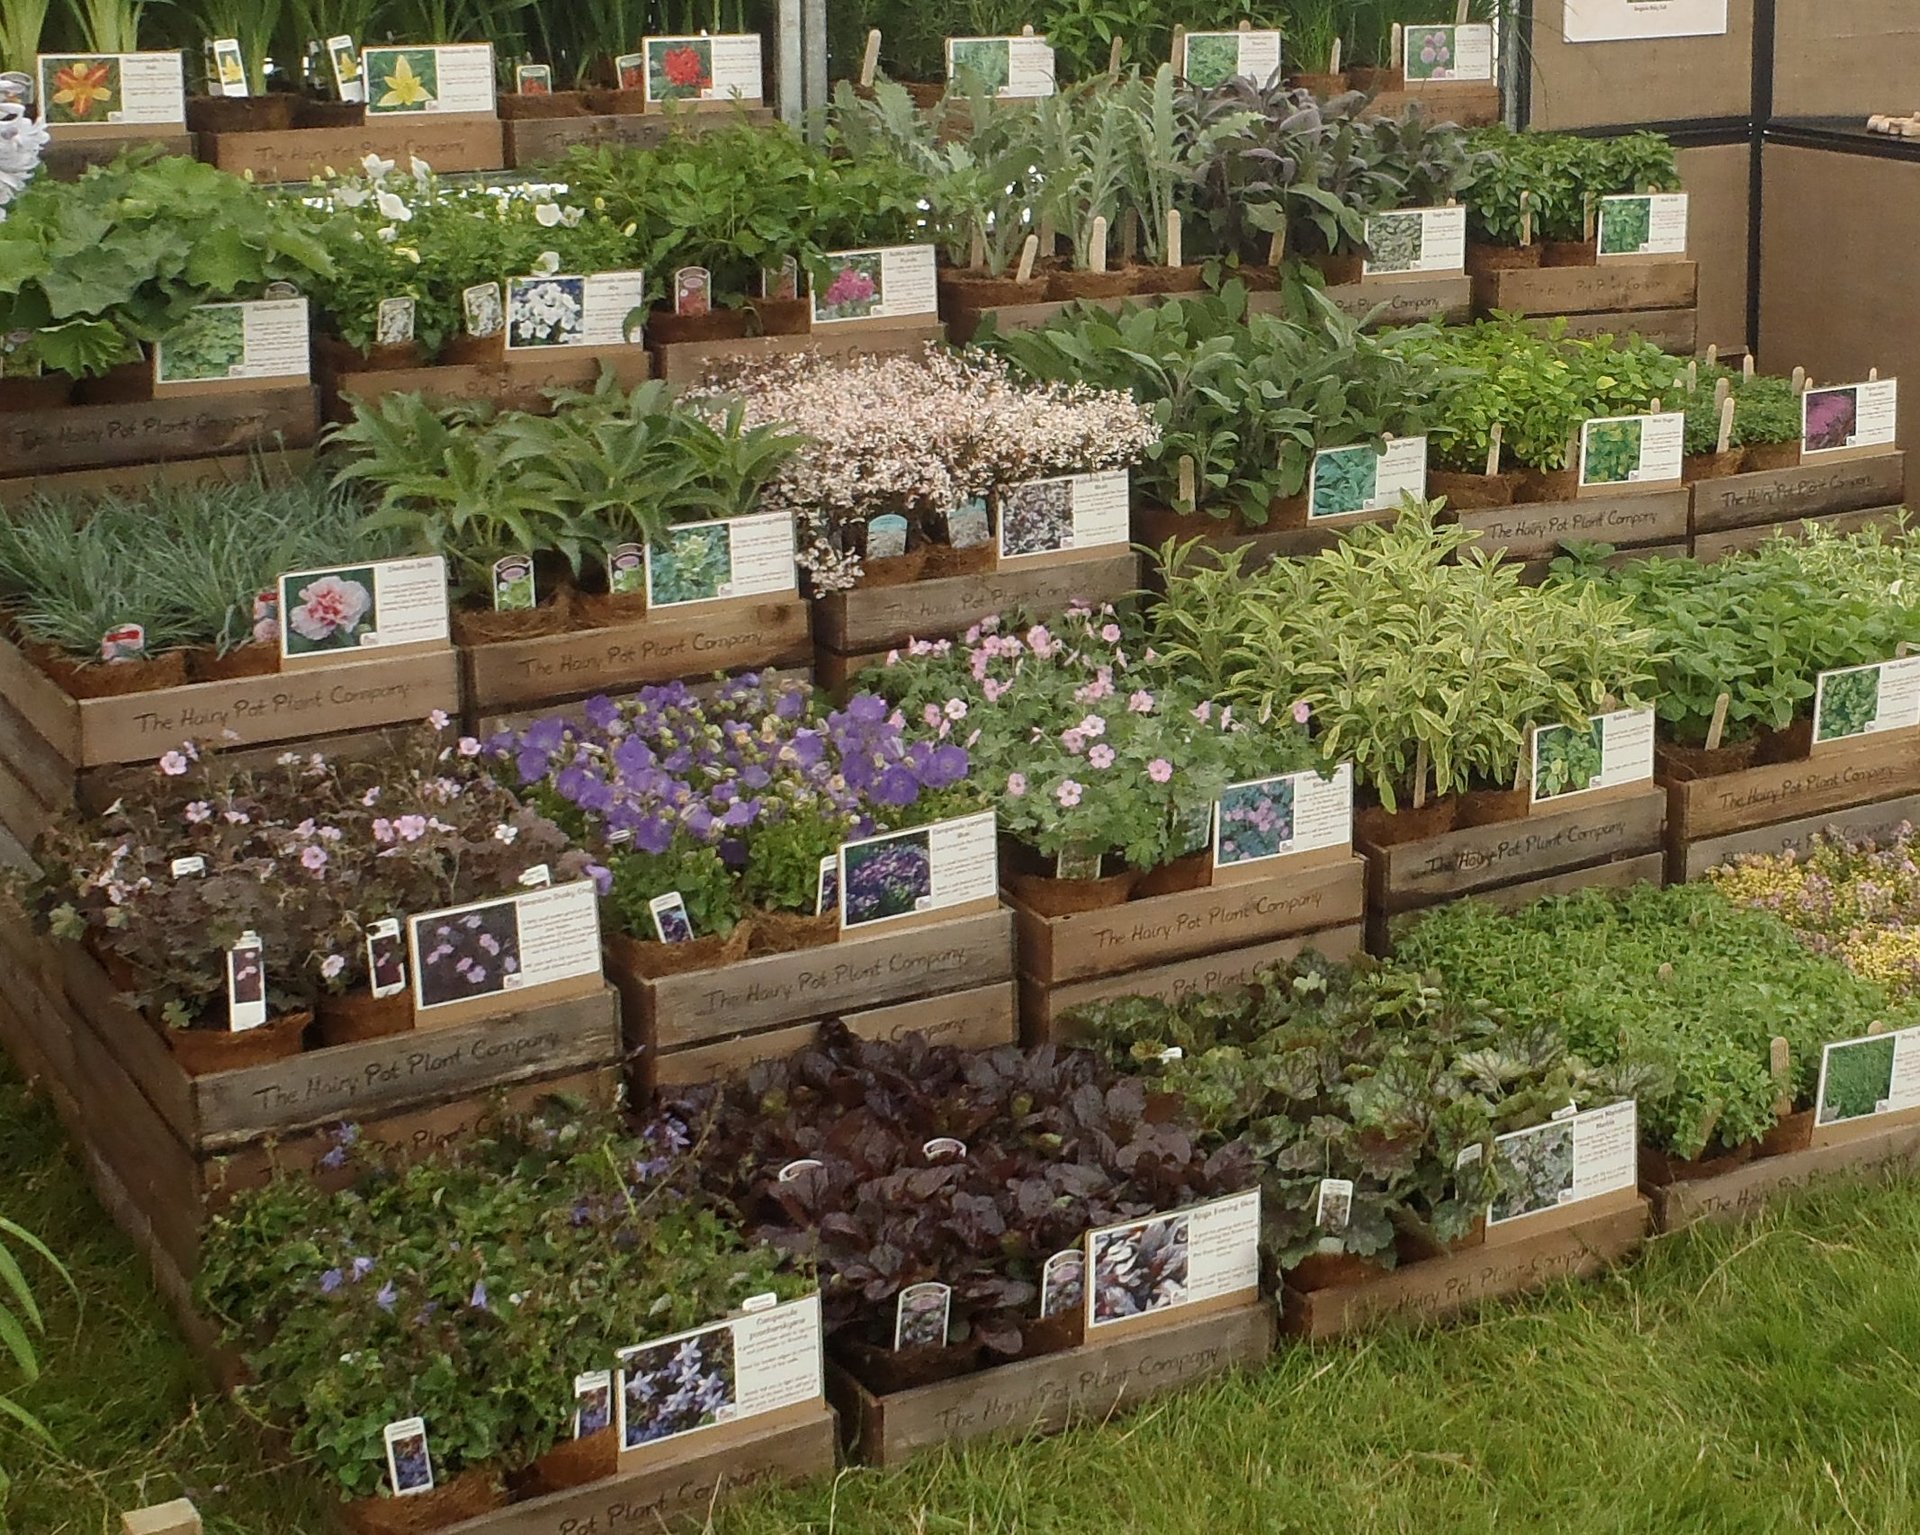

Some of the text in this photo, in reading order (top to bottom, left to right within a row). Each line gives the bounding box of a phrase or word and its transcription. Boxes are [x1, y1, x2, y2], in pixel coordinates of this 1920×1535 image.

[1390, 293, 1440, 313] Company
[1488, 509, 1659, 540] The Hairy Pot Plant Company
[518, 657, 553, 677] The
[607, 645, 637, 664] Pot
[641, 639, 686, 660] Plant
[691, 632, 764, 652] Company
[133, 683, 408, 734] The Hairy Pot Plant Company
[1718, 765, 1895, 809] The Hairy Pot Plant Company
[1457, 851, 1495, 871] Hairy
[1498, 840, 1522, 861] Pot
[1525, 834, 1564, 854] Plant
[1566, 820, 1627, 844] Company
[1093, 890, 1324, 949] The Hairy Pot Plant Company
[701, 948, 969, 1014] The Hairy Pot Plant Company
[1203, 967, 1248, 991] Plant
[252, 1031, 562, 1110] The Hairy Pot Plant Company
[1444, 1273, 1472, 1299] Pot
[934, 1406, 976, 1430] The
[1136, 1345, 1219, 1375] Company
[559, 1513, 599, 1535] Pot
[607, 1492, 667, 1529] Plant
